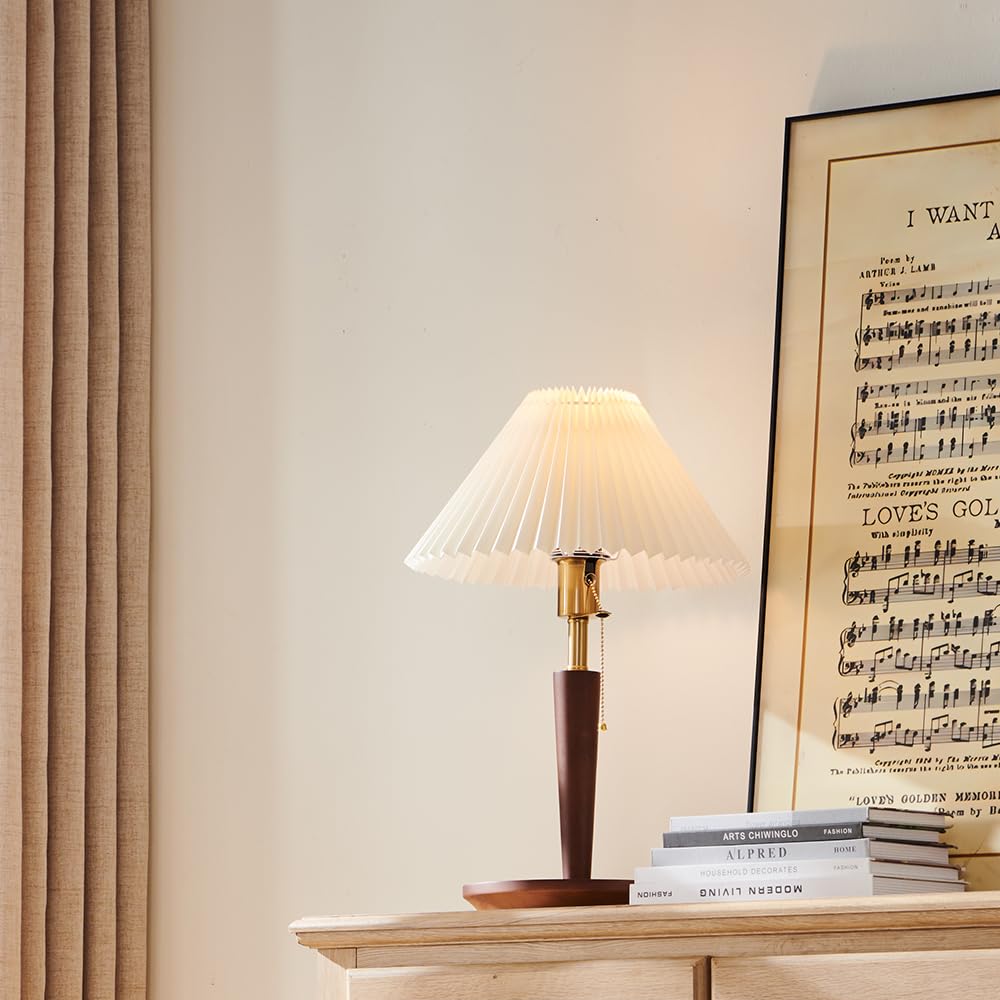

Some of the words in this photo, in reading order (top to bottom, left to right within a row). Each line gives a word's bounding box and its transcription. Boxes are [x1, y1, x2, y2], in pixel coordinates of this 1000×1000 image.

[907, 210, 915, 227] I
[926, 200, 994, 225] WANT
[905, 254, 915, 264] by
[862, 501, 939, 526] LOVE'S
[901, 793, 947, 804] GOLDEN
[970, 807, 982, 817] by
[722, 830, 746, 841] ARTS
[748, 829, 799, 840] CHIWINGLO
[823, 827, 852, 835] FASHION
[726, 847, 788, 861] ALPRED
[700, 868, 748, 878] HOUSEHOLD
[751, 866, 798, 875] DECORATES
[699, 887, 741, 898] LIVING
[748, 884, 803, 896] MODERN
